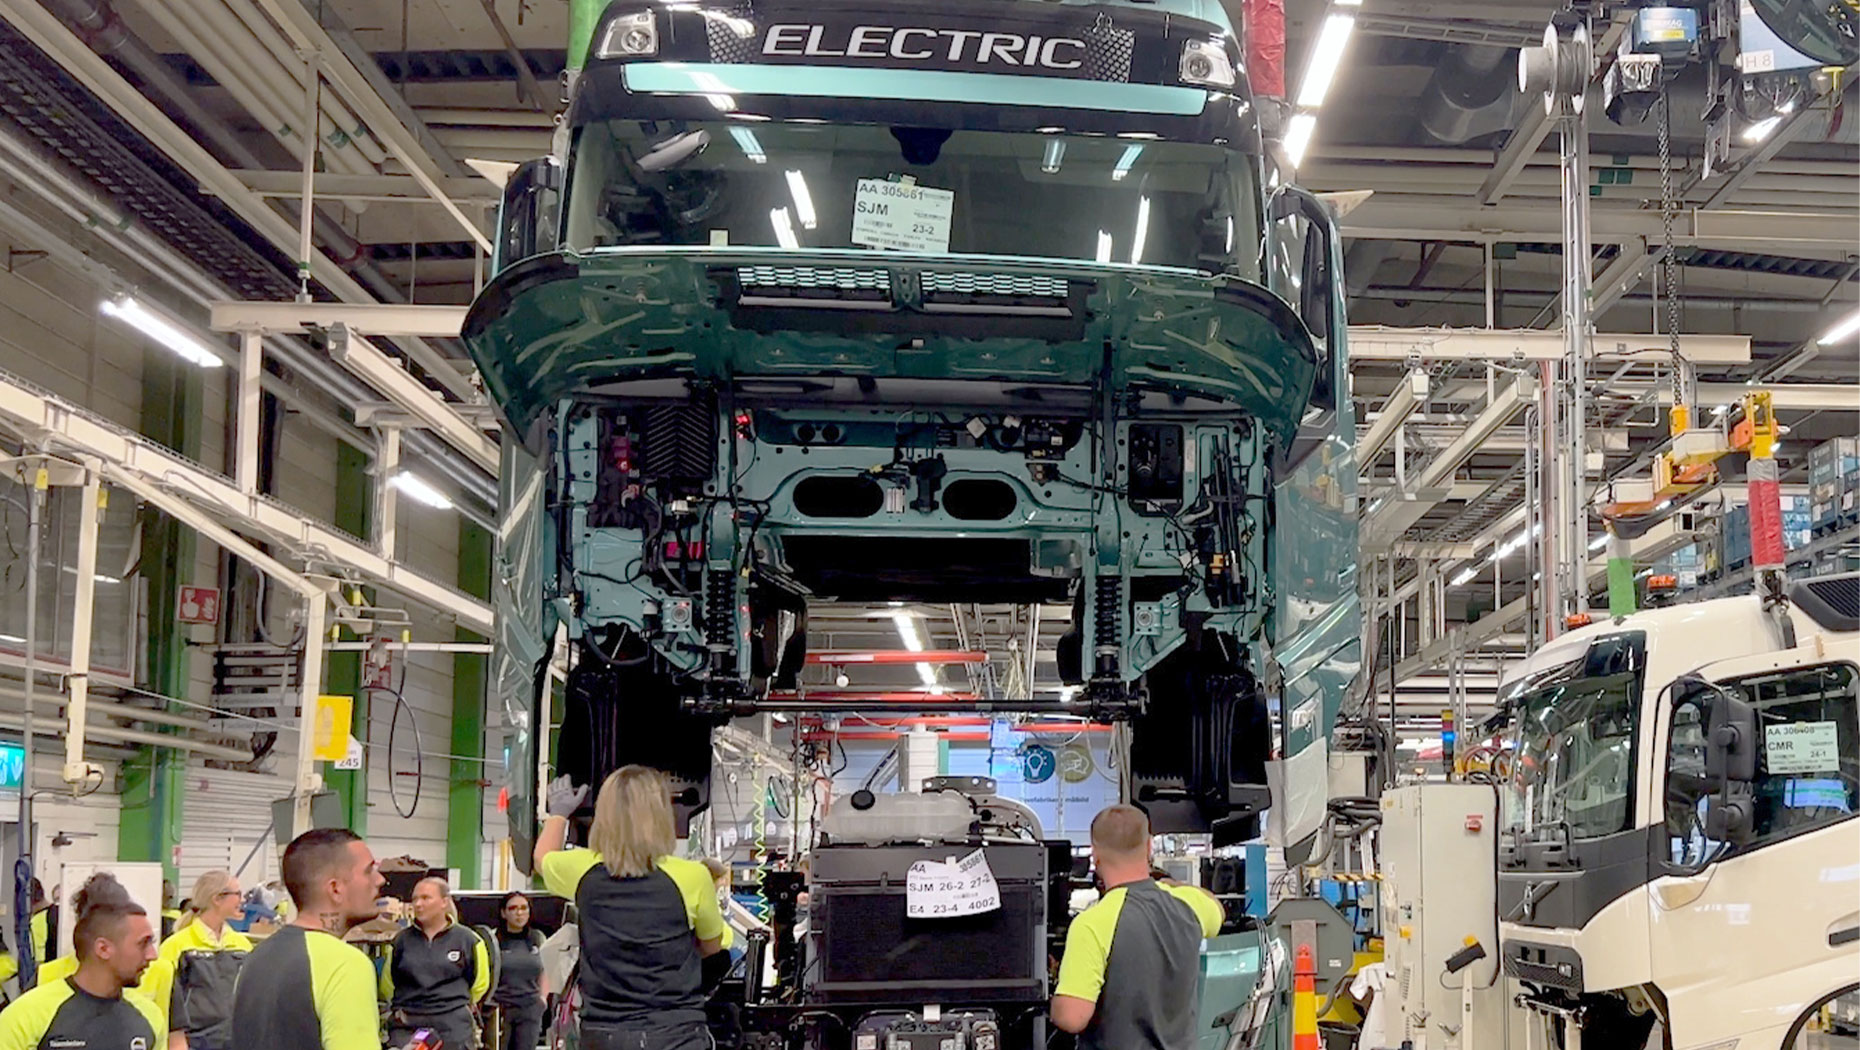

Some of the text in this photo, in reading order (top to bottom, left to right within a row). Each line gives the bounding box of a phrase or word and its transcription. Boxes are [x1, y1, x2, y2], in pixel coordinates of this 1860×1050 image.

[762, 24, 1086, 68] ELECTRIC
[1745, 55, 1772, 68] H 8
[859, 183, 878, 194] AA
[857, 200, 888, 216] SJM
[912, 223, 935, 235] 23-2
[1767, 728, 1781, 736] AA
[1767, 741, 1794, 751] CMR
[1810, 750, 1826, 758] 24-1
[910, 863, 926, 873] AA
[909, 873, 991, 892] SJM 26-2 27-2
[909, 904, 924, 914] E4
[933, 904, 958, 914] 23-4
[968, 896, 995, 910] 4002
